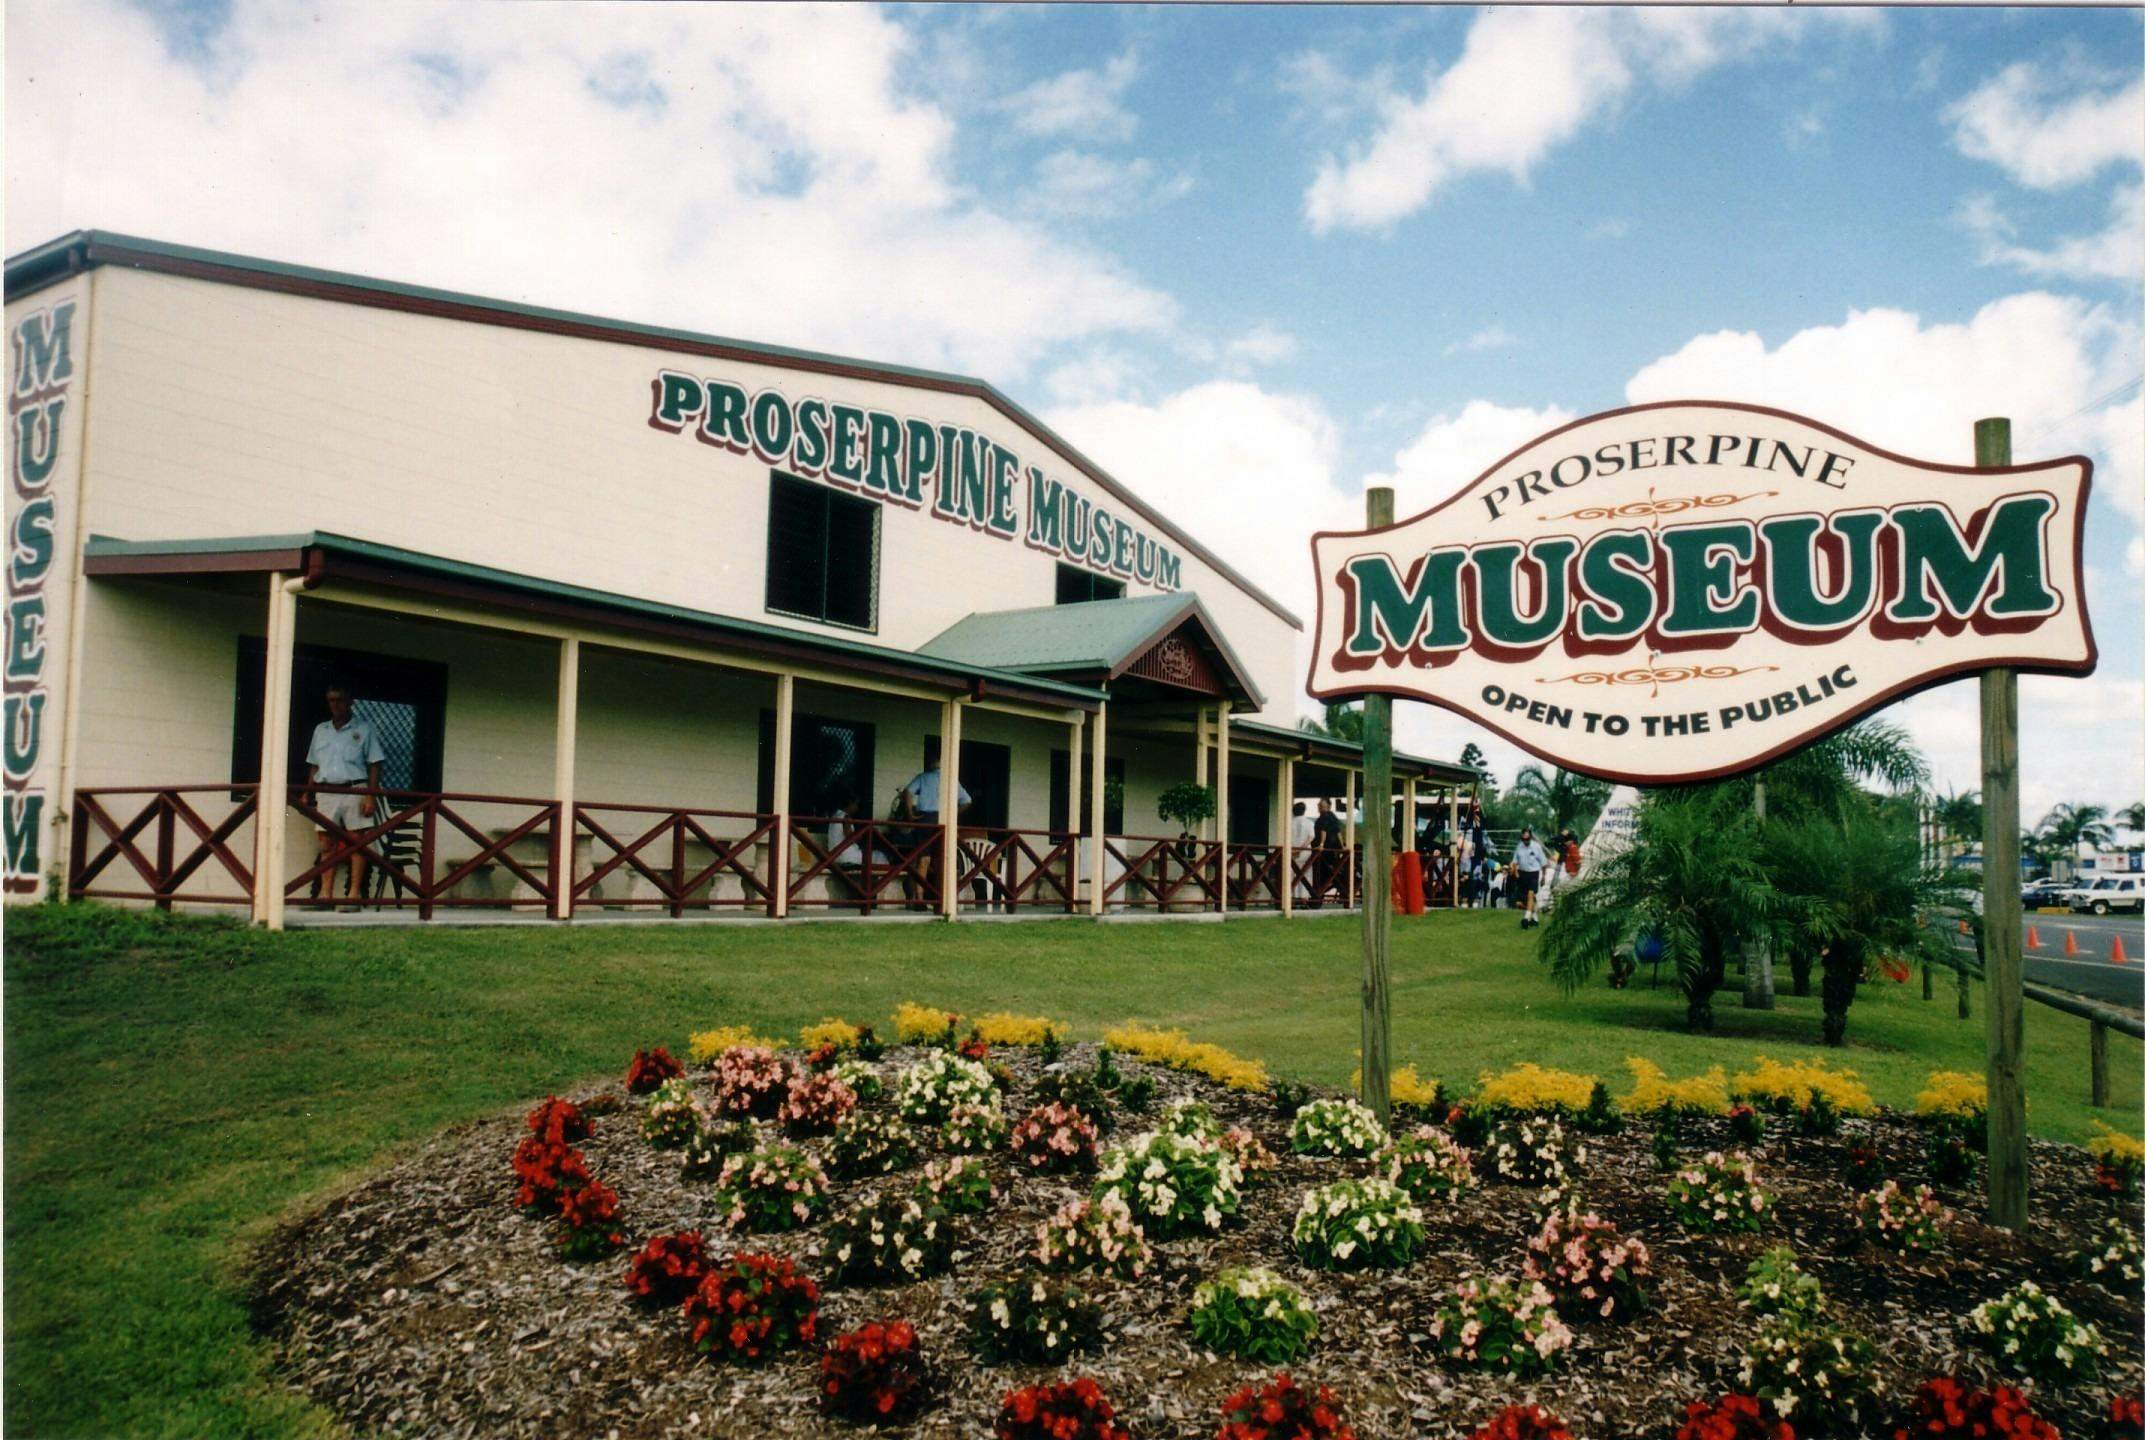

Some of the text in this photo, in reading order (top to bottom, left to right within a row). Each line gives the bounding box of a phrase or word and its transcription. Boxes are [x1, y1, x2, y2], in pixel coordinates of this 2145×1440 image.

[649, 368, 1182, 591] PROSERPINE MUSEUM
[1479, 434, 1857, 523] PROSERPINE
[3, 298, 77, 894] MUSEUM
[1334, 490, 2064, 672] MUSEUM
[1481, 663, 1859, 738] OPEN TO THE PUBLIC
